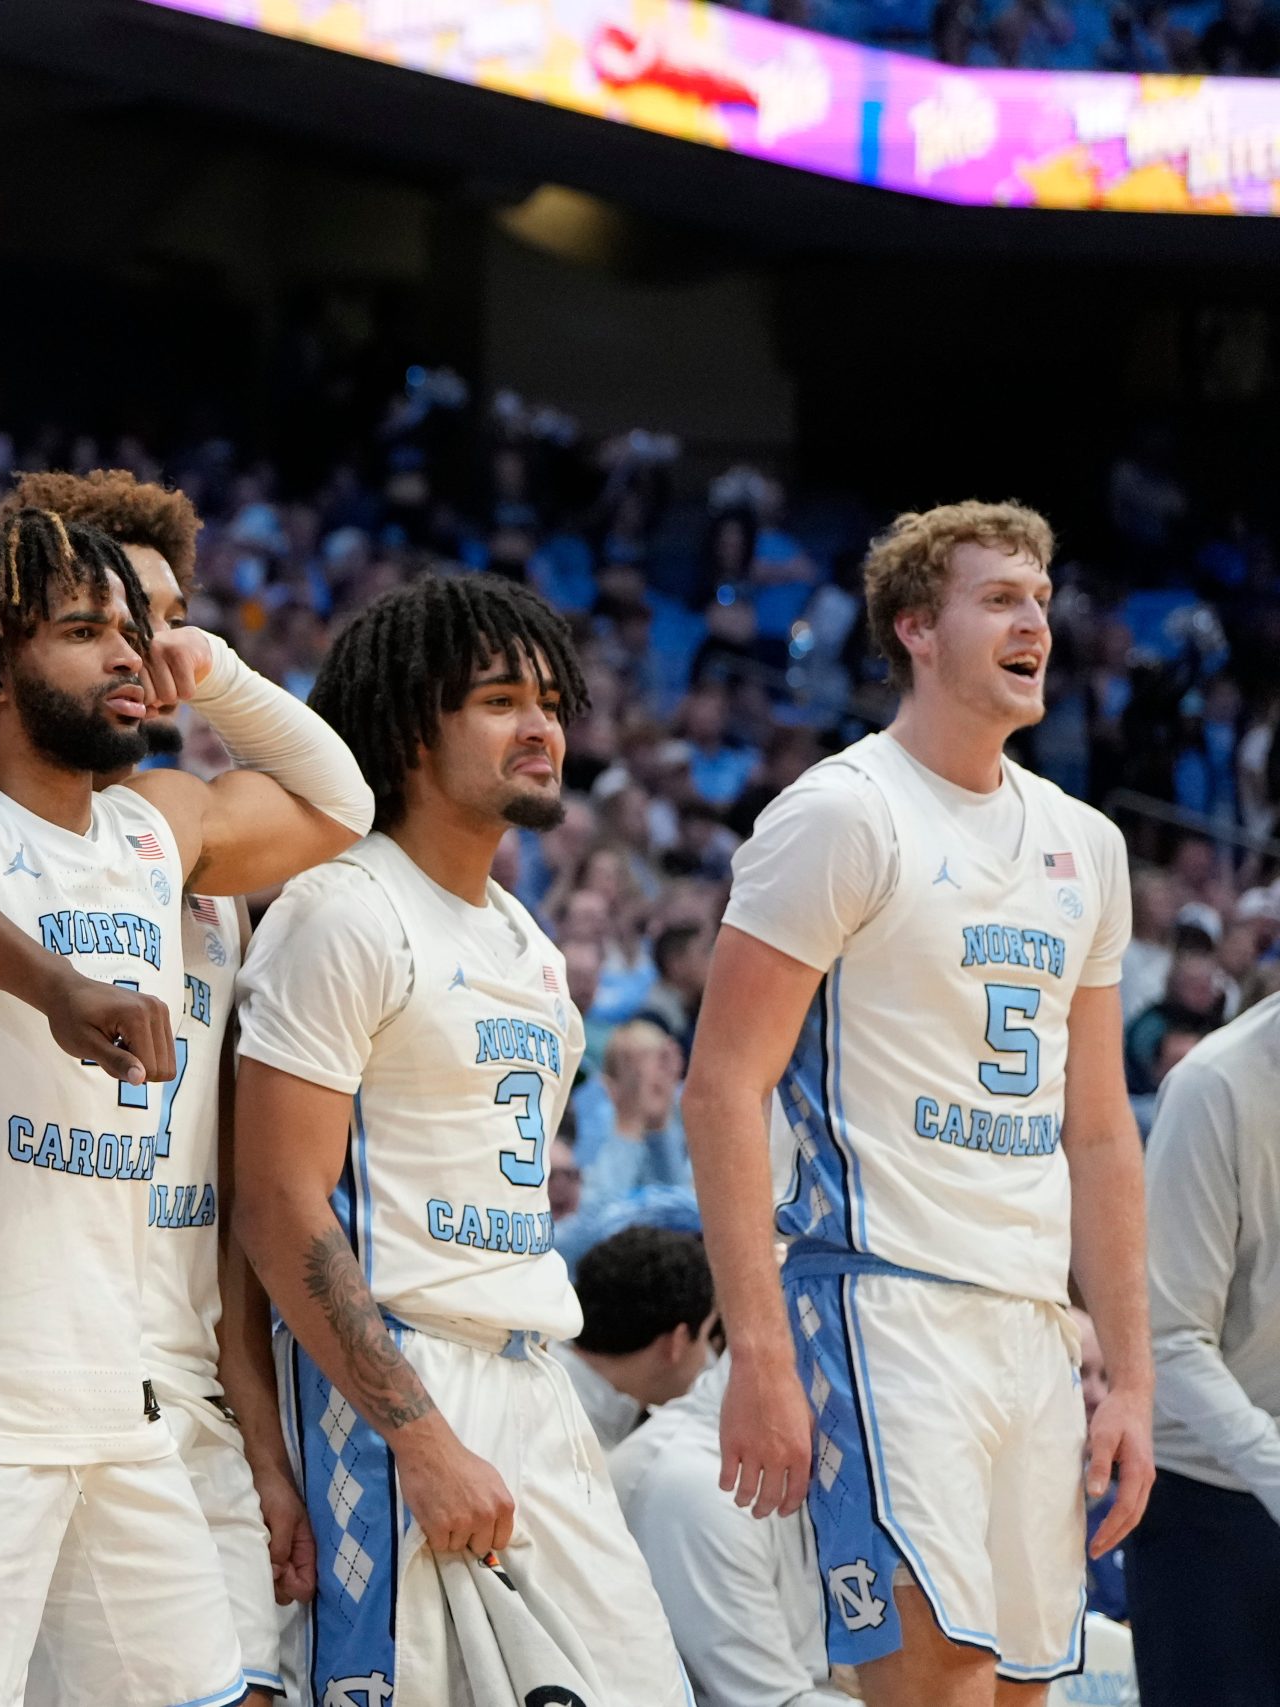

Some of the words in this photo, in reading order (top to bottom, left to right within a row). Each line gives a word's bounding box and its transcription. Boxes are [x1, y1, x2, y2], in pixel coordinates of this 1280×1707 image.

[39, 911, 161, 971] NORTH
[961, 924, 1065, 978] NORTH
[476, 1018, 560, 1078] NORTH
[978, 984, 1040, 1097] 5
[494, 1071, 545, 1187] 3
